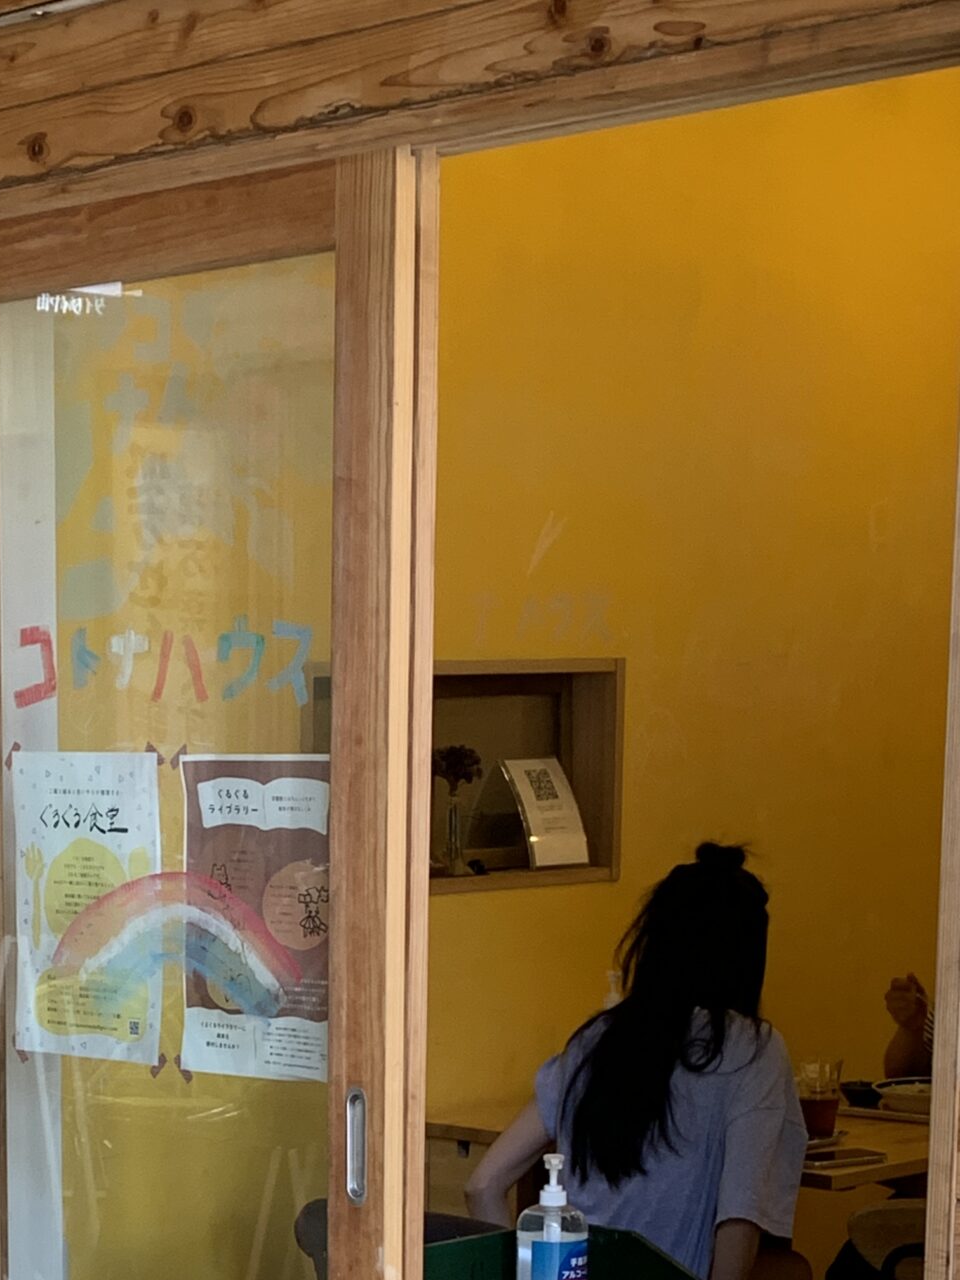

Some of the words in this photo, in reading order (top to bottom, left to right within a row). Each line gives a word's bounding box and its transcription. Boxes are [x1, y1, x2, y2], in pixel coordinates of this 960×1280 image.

[13, 613, 313, 708] コトナハウス
[208, 803, 259, 815] ライブラリー
